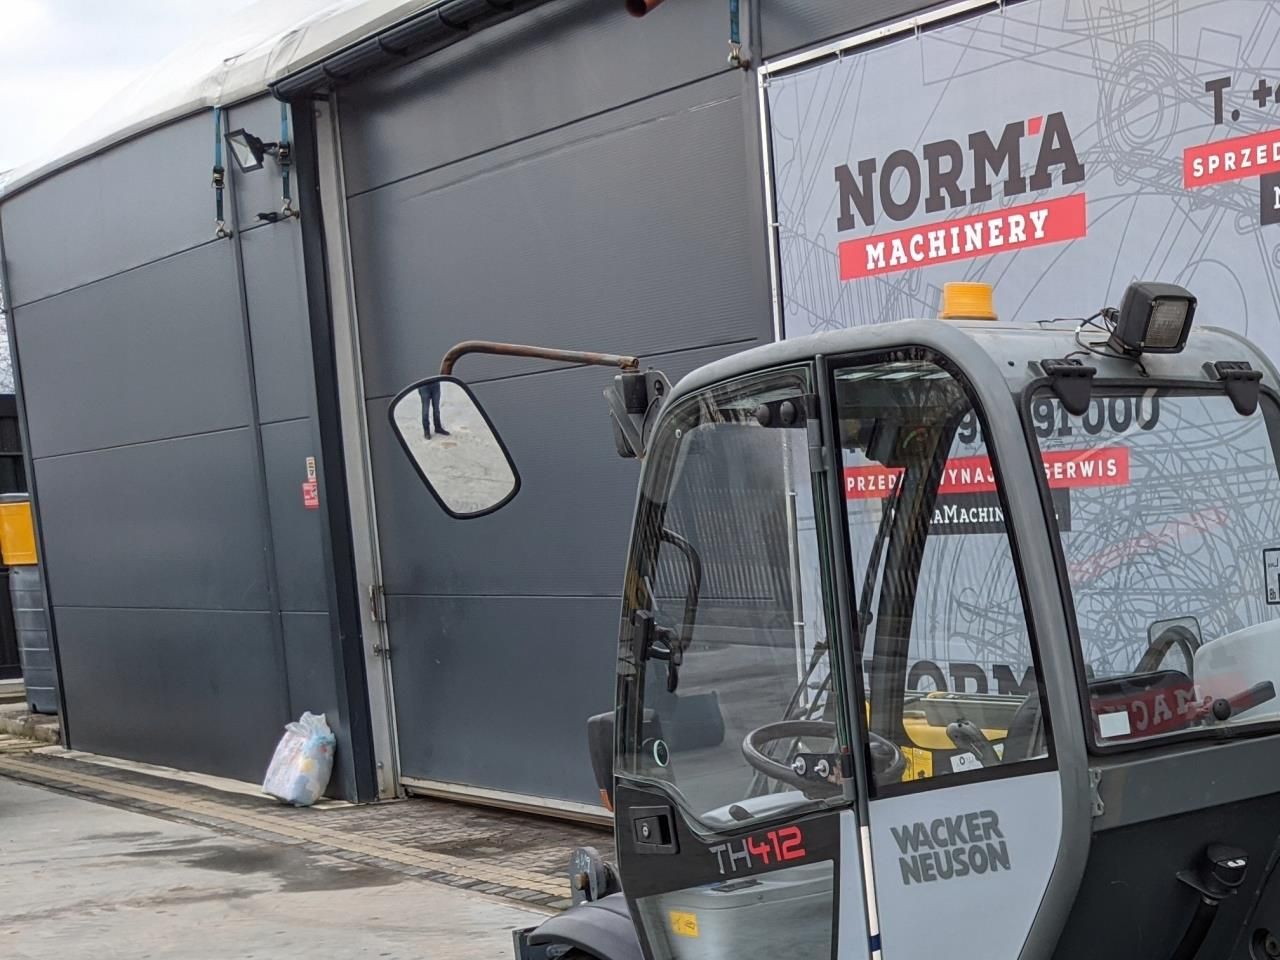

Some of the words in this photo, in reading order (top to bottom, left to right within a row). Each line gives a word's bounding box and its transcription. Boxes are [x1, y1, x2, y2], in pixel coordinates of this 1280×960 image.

[1205, 76, 1240, 125] T.
[834, 111, 1086, 233] NORMA
[866, 209, 1049, 271] MACHINERY
[709, 825, 807, 875] TH412
[889, 808, 1005, 856] WACKER
[898, 840, 1012, 886] NEUSON
